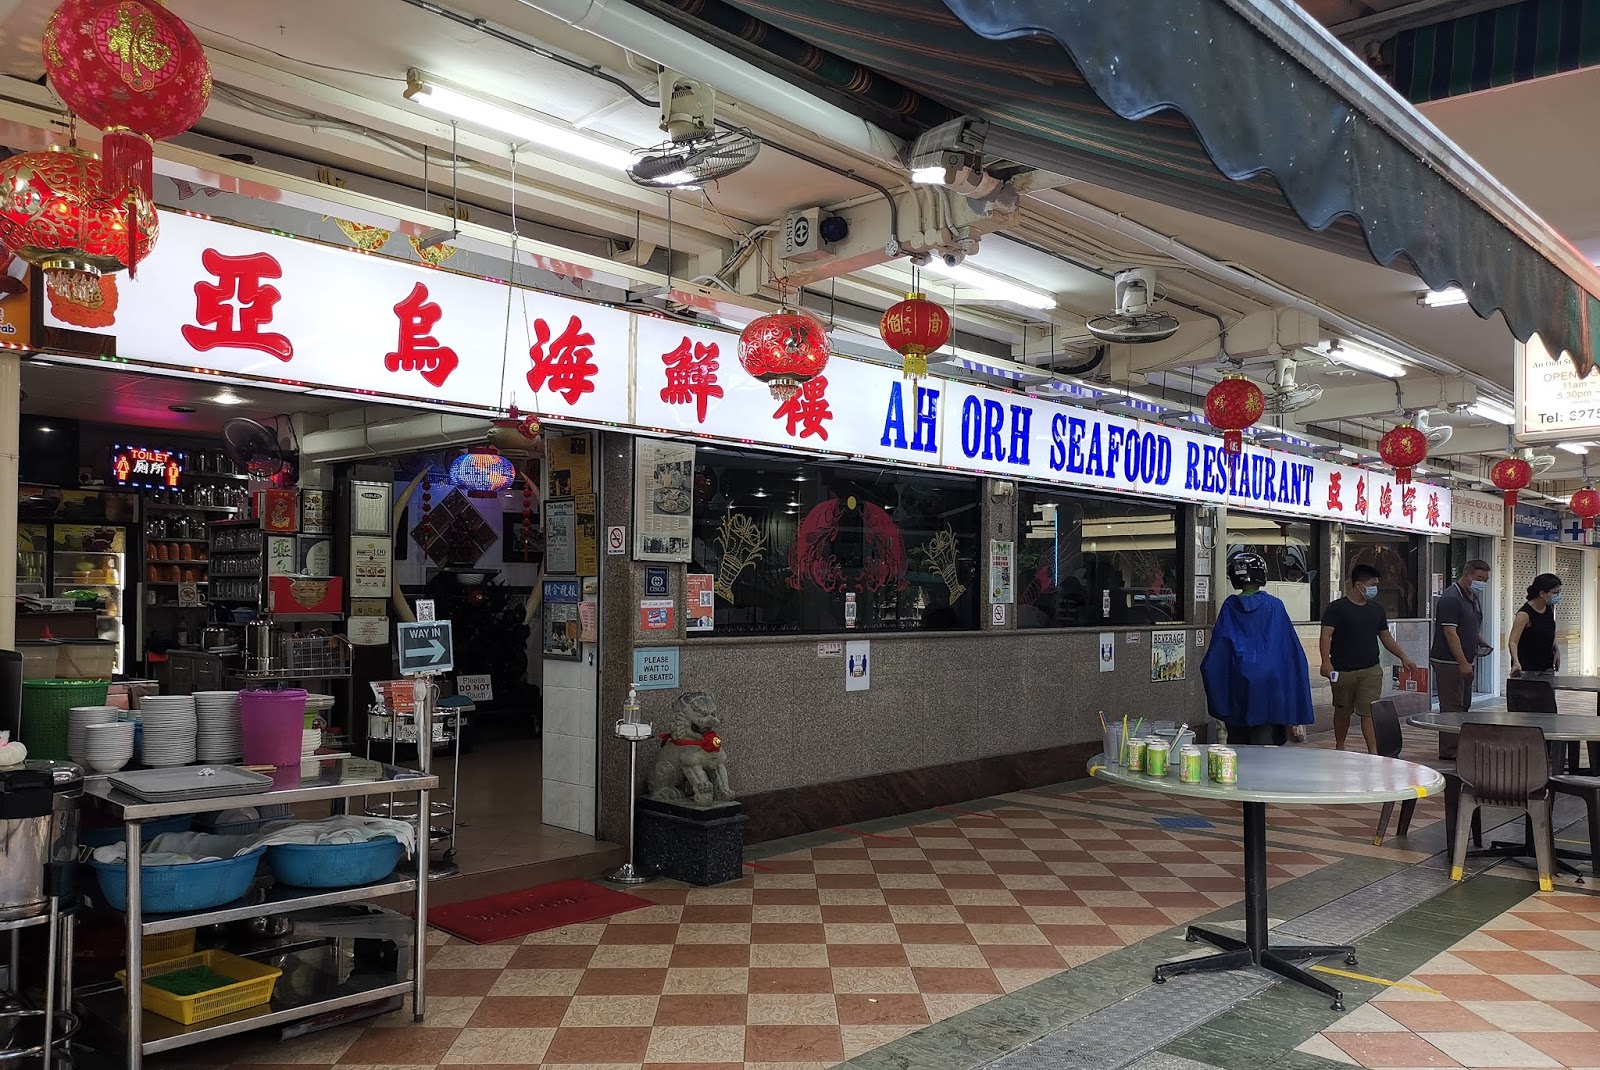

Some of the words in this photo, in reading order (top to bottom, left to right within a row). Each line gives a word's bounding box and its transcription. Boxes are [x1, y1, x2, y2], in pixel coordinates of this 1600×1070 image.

[106, 9, 172, 77] 福
[786, 218, 794, 252] CISCO
[1538, 412, 1564, 424] Tel:
[880, 381, 940, 453] AH
[961, 394, 1033, 466] ORH
[1049, 412, 1173, 486] SEAFOOD
[1184, 441, 1314, 507] RESTAURANT
[131, 449, 170, 462] TOILET
[409, 629, 430, 639] WAY
[431, 628, 441, 637] IN
[1153, 633, 1185, 644] BEVERAGE
[649, 673, 674, 681] SEATED
[473, 683, 490, 691] NOT
